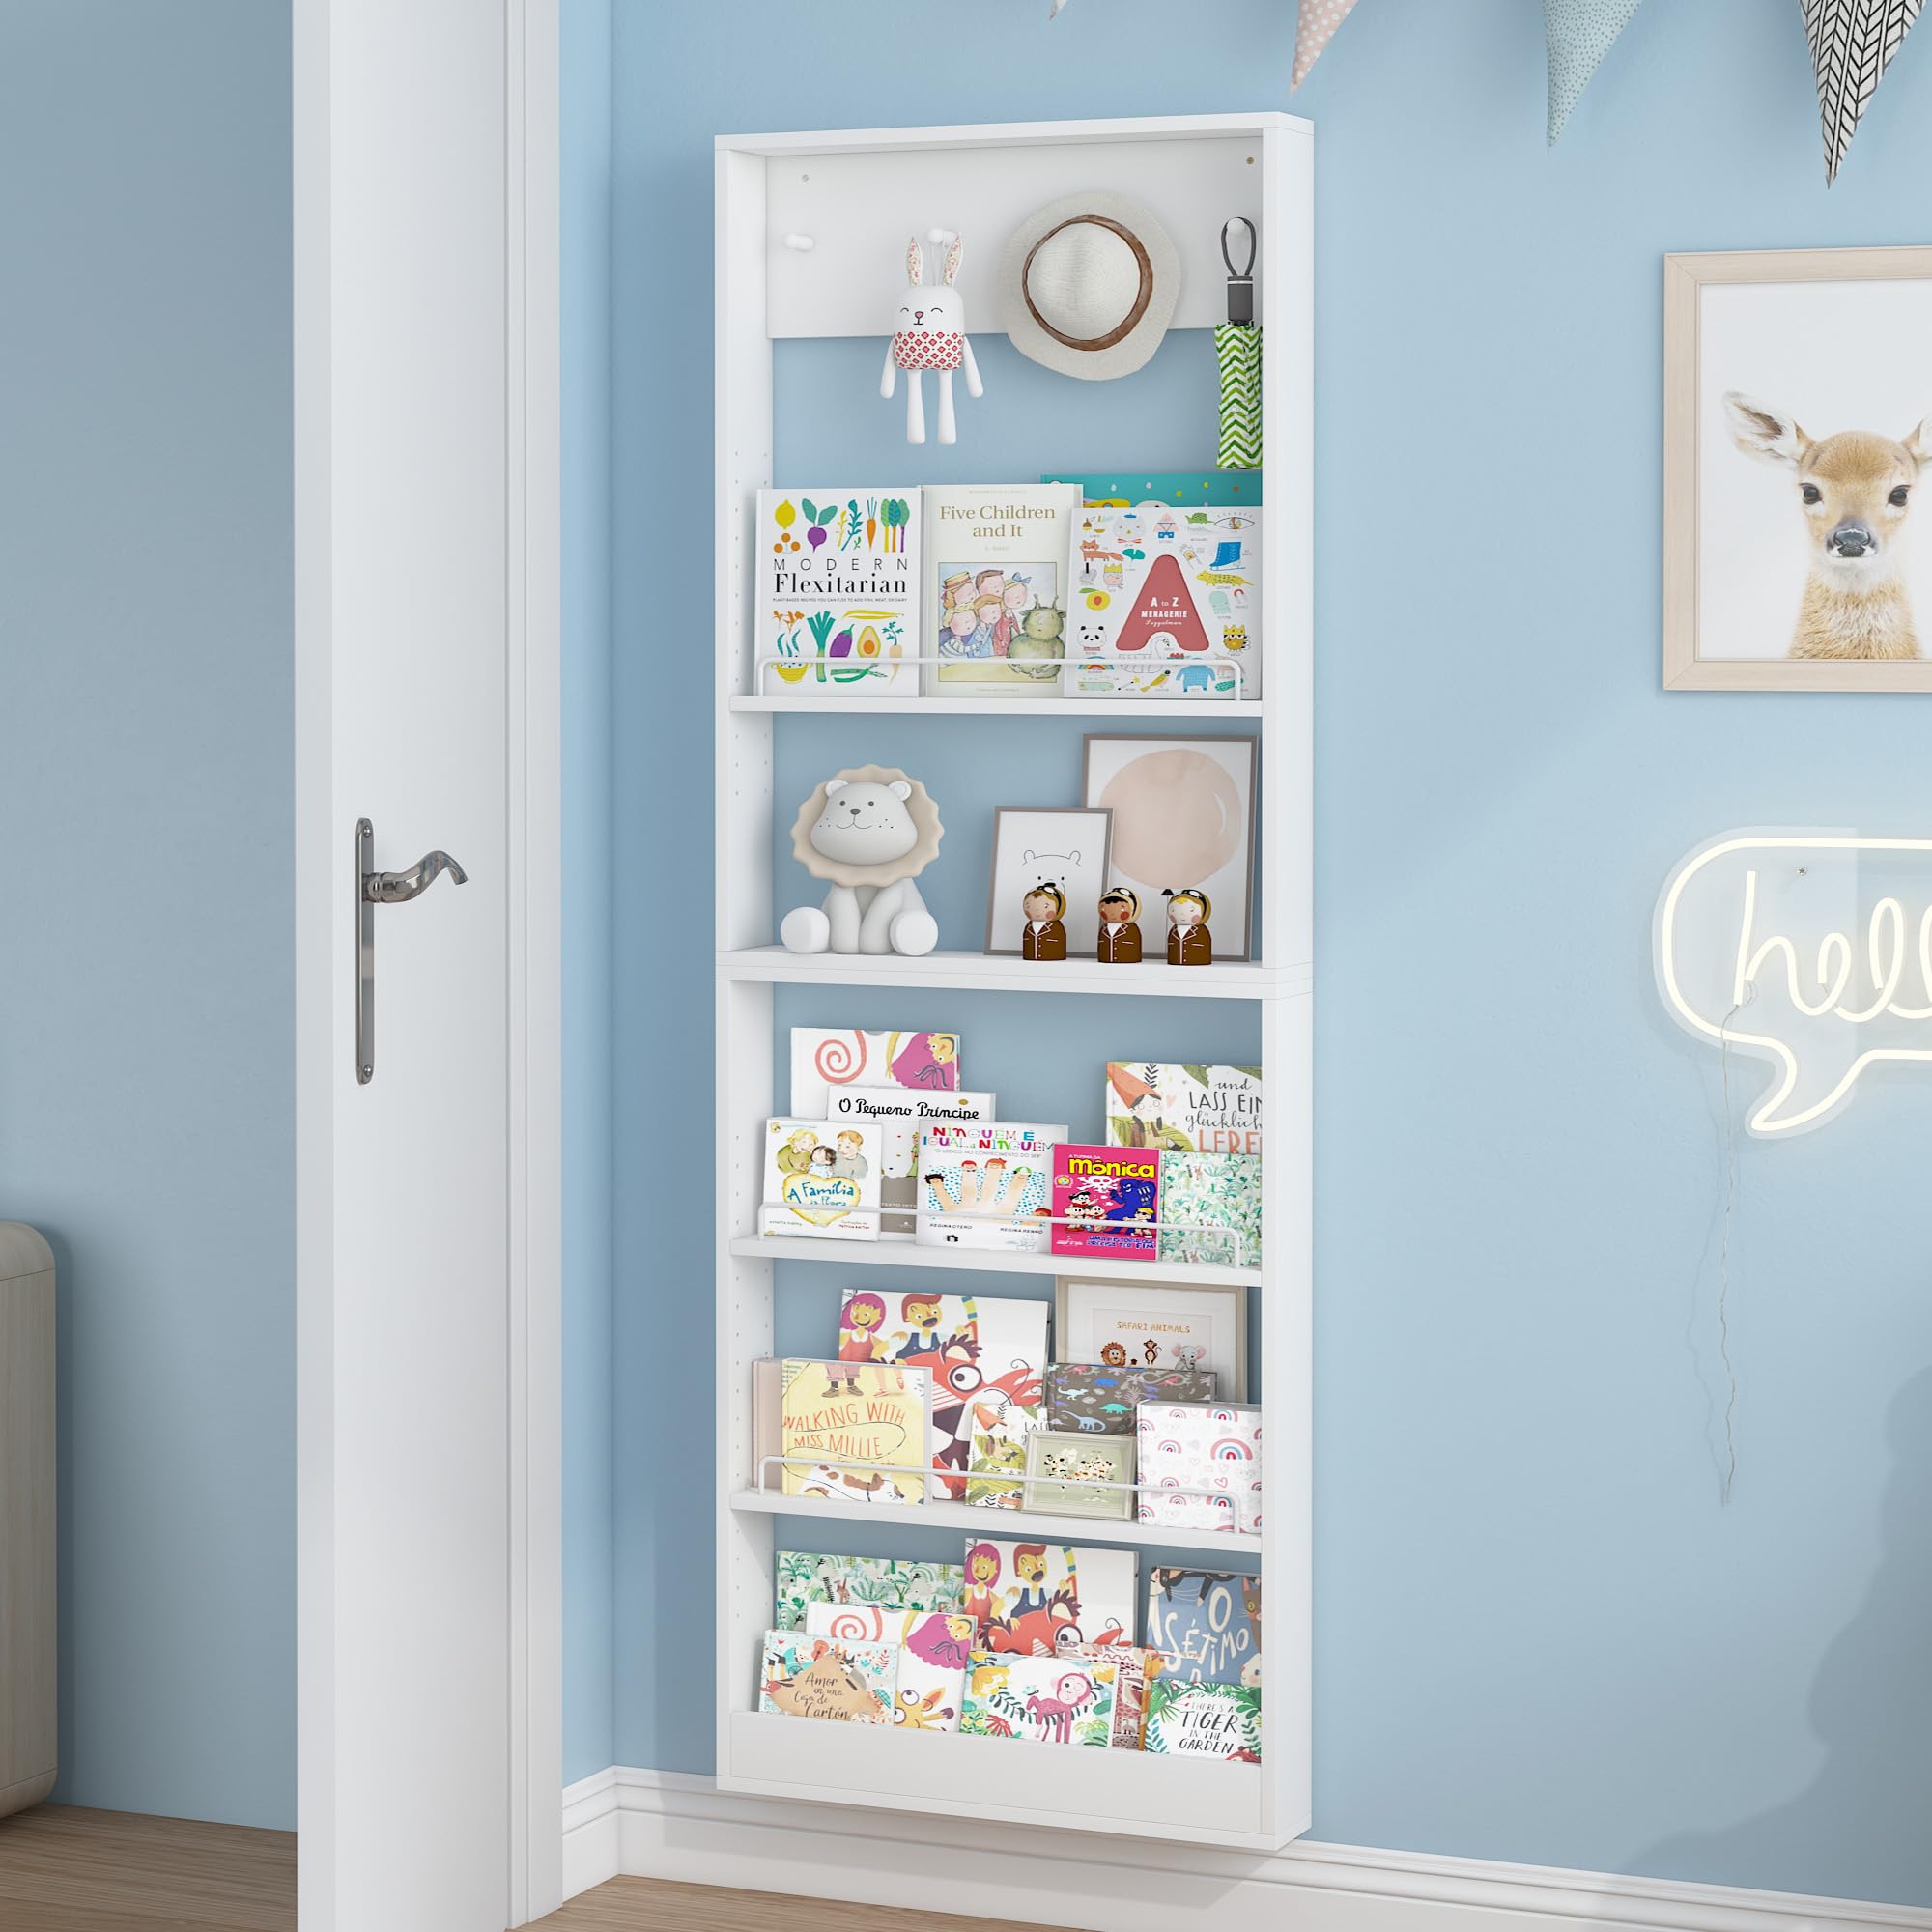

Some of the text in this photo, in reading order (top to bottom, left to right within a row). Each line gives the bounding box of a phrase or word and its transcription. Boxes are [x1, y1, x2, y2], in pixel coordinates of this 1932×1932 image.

[939, 504, 1056, 520] Five Children
[972, 523, 1022, 538] and It
[774, 558, 908, 571] MODERN
[774, 572, 906, 594] Flexitarian
[1151, 596, 1158, 608] A
[1172, 596, 1179, 608] Z
[1214, 1077, 1252, 1090] und
[838, 1097, 980, 1120] O Pequeno Príncipe
[1189, 1091, 1227, 1112] LASS
[787, 1180, 855, 1205] A Família
[1116, 1321, 1191, 1334] SAFARI ANIMALS
[782, 1401, 905, 1431] WALKING WITH
[794, 1433, 883, 1458] MISS MILLIE
[1208, 1586, 1232, 1633] O
[805, 1672, 838, 1688] Amor
[805, 1701, 848, 1720] Cartón
[1180, 1710, 1239, 1734] TIGER
[1179, 1737, 1235, 1754] GARDEN
